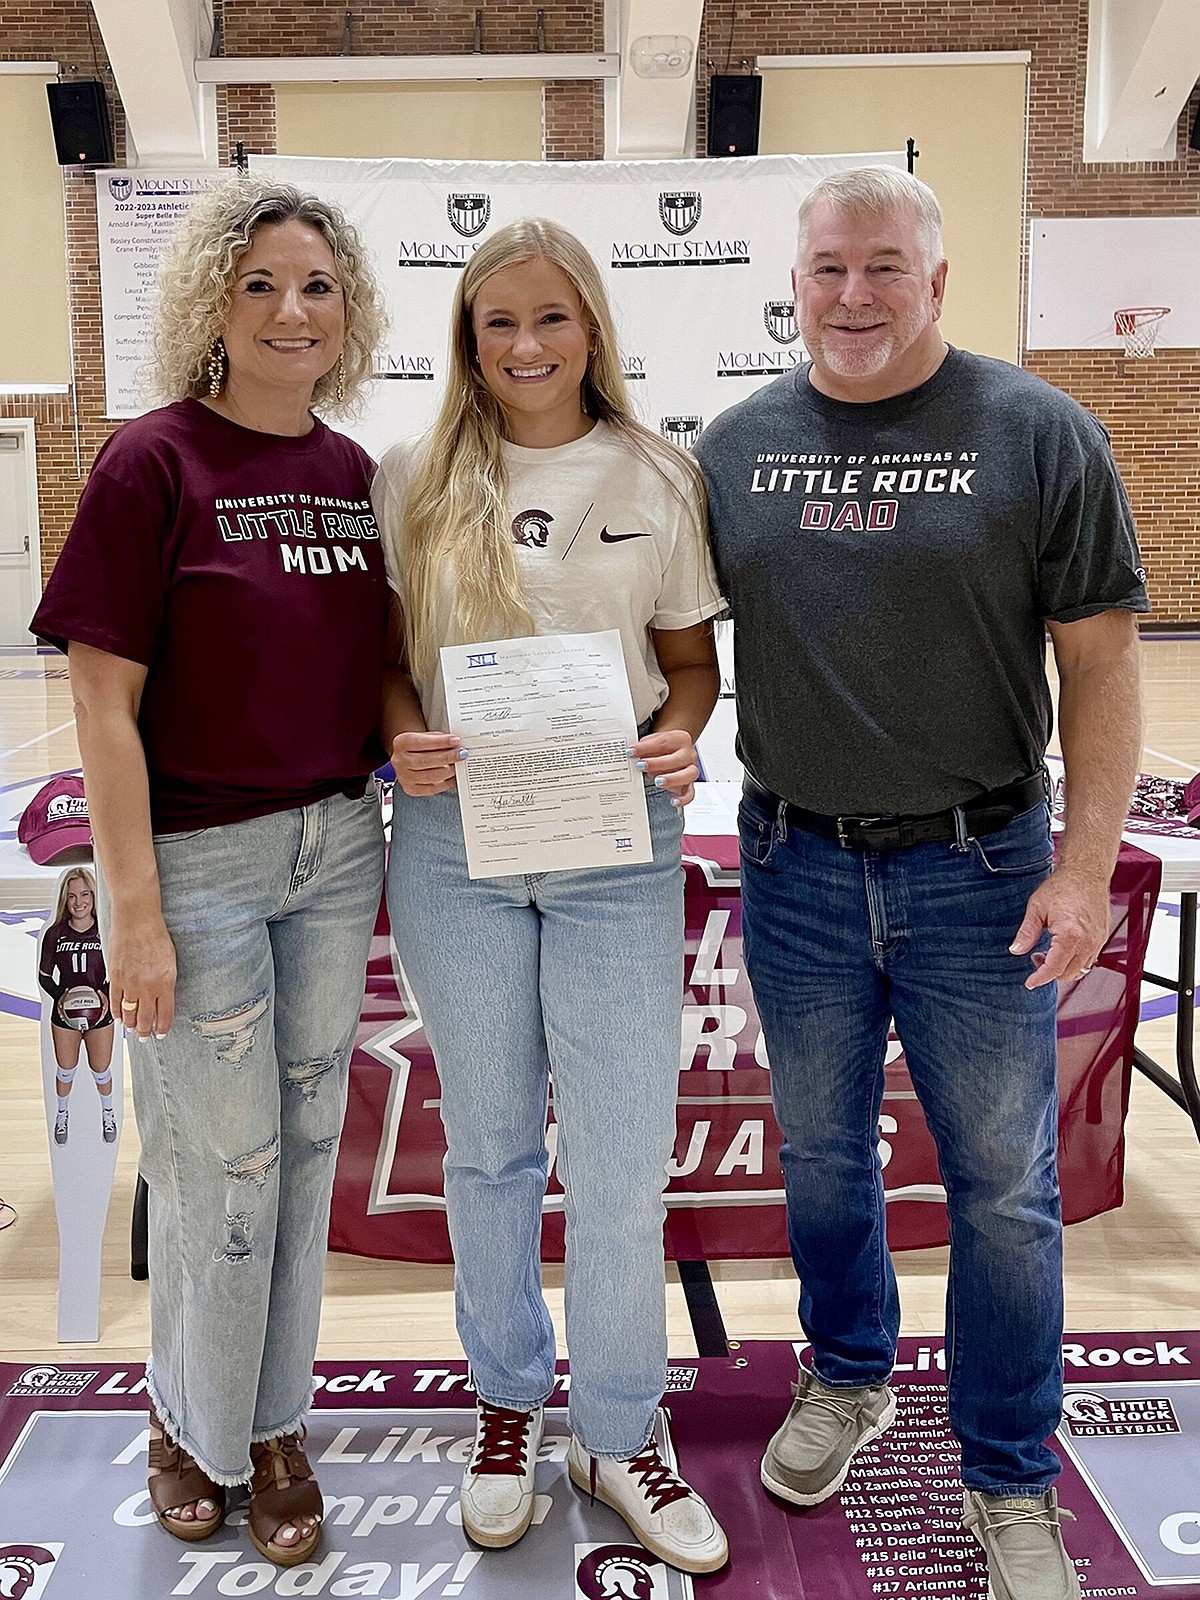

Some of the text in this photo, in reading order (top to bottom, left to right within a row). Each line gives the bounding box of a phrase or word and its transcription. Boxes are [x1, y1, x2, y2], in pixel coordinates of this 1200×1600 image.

[136, 179, 179, 190] MOUNT
[399, 241, 469, 259] MOUNT
[612, 240, 751, 259] MOUNT ST. MARY
[388, 355, 434, 371] MARY
[718, 350, 807, 368] MOUNT ST
[756, 452, 978, 465] UNIVERSITY OF ARKANSAS AT
[751, 468, 978, 496] LITTLE ROCK
[216, 493, 370, 511] UNIVERSITY OF ARKANSAS
[800, 500, 899, 532] DAD
[217, 509, 379, 542] LITTLE ROC
[280, 543, 369, 575] MOM
[56, 942, 80, 953] LITTLE
[72, 953, 87, 973] 11
[892, 1341, 1191, 1371] Lit Rock
[313, 1369, 396, 1392] ck
[909, 1384, 949, 1392] Roma
[1110, 1400, 1170, 1412] LITTLE
[1112, 1410, 1172, 1422] ROCK
[1074, 1423, 1175, 1436] VOLLEYBALL
[318, 1427, 475, 1463] Like
[882, 1441, 917, 1451] “LIT”
[884, 1453, 935, 1463] “YOLO”
[840, 1496, 867, 1506] #11
[869, 1493, 919, 1506] Kaylee
[845, 1509, 873, 1519] #12
[874, 1505, 926, 1519] Sophia
[850, 1522, 878, 1533] #13
[880, 1520, 922, 1532] Daria
[855, 1533, 975, 1548] #14 Daedrianna
[861, 1551, 889, 1563] #15
[930, 1546, 982, 1560] “Legit”
[169, 1551, 484, 1600] Today!
[866, 1566, 895, 1578] #16
[898, 1562, 963, 1576] Carolina
[872, 1581, 900, 1593] #17
[905, 1579, 967, 1592] Arianna
[1080, 1586, 1137, 1598] armona
